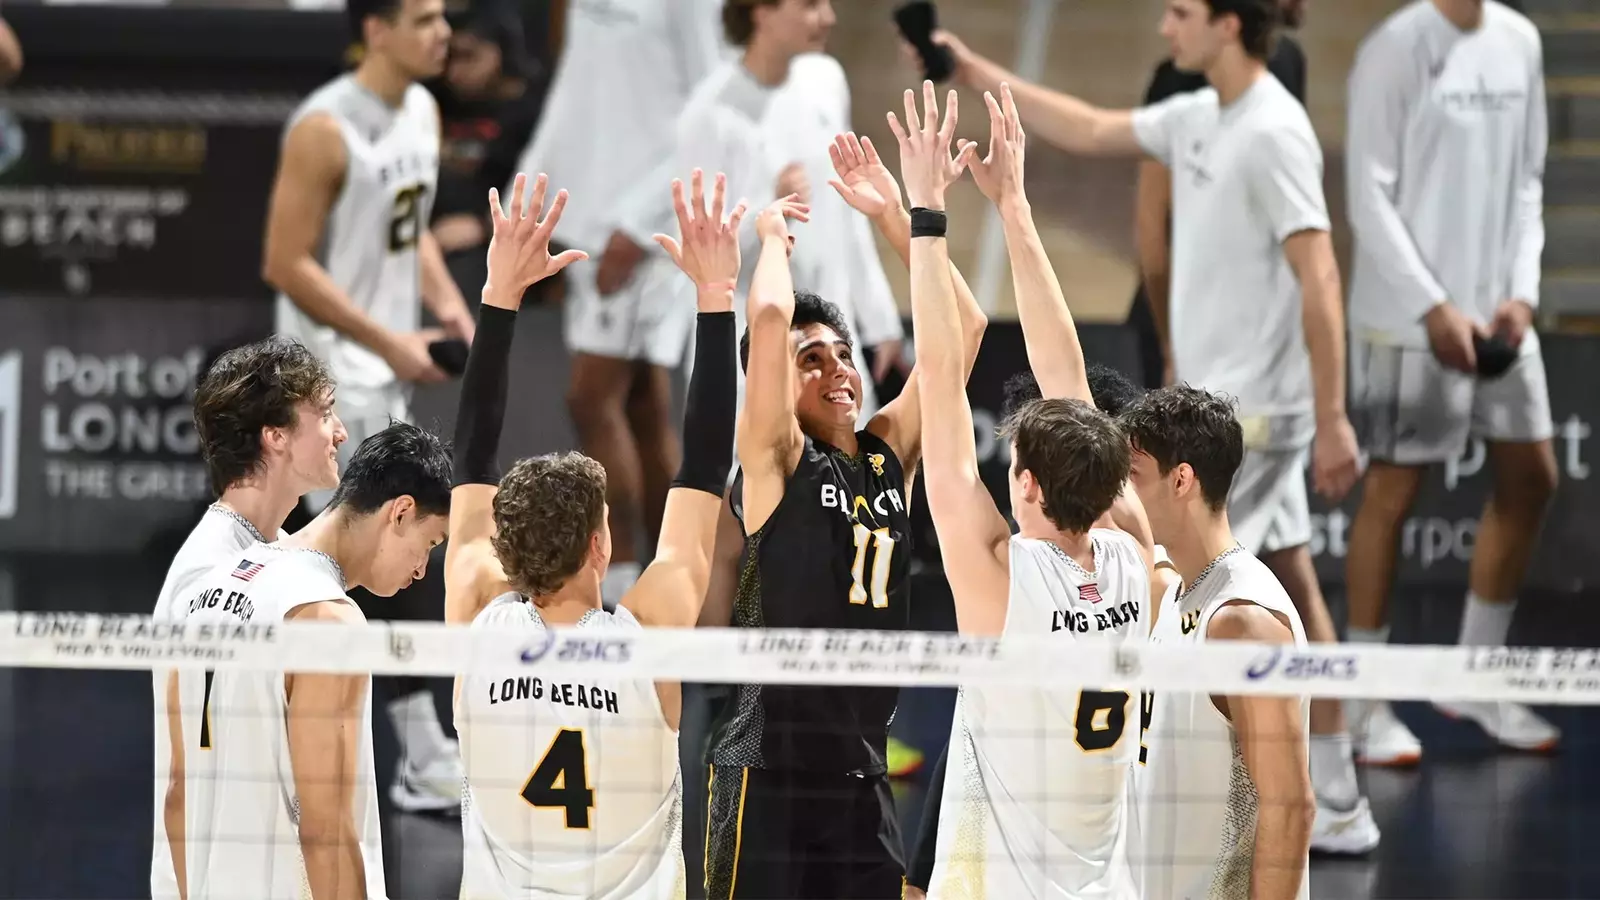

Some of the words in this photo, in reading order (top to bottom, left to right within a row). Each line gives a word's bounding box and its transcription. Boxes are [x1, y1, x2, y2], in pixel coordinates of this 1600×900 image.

[43, 346, 147, 397] Port
[152, 346, 204, 398] of
[46, 460, 112, 499] THE
[849, 523, 895, 608] 11
[14, 616, 86, 638] LONG
[98, 616, 187, 642] BEACH
[198, 623, 277, 644] STATE
[1051, 609, 1089, 633] LNG
[557, 638, 632, 663] asics
[738, 629, 813, 655] LONG
[822, 631, 912, 656] BEACH
[489, 676, 544, 704] LONG
[550, 683, 619, 714] BEACH
[518, 725, 597, 830] 4
